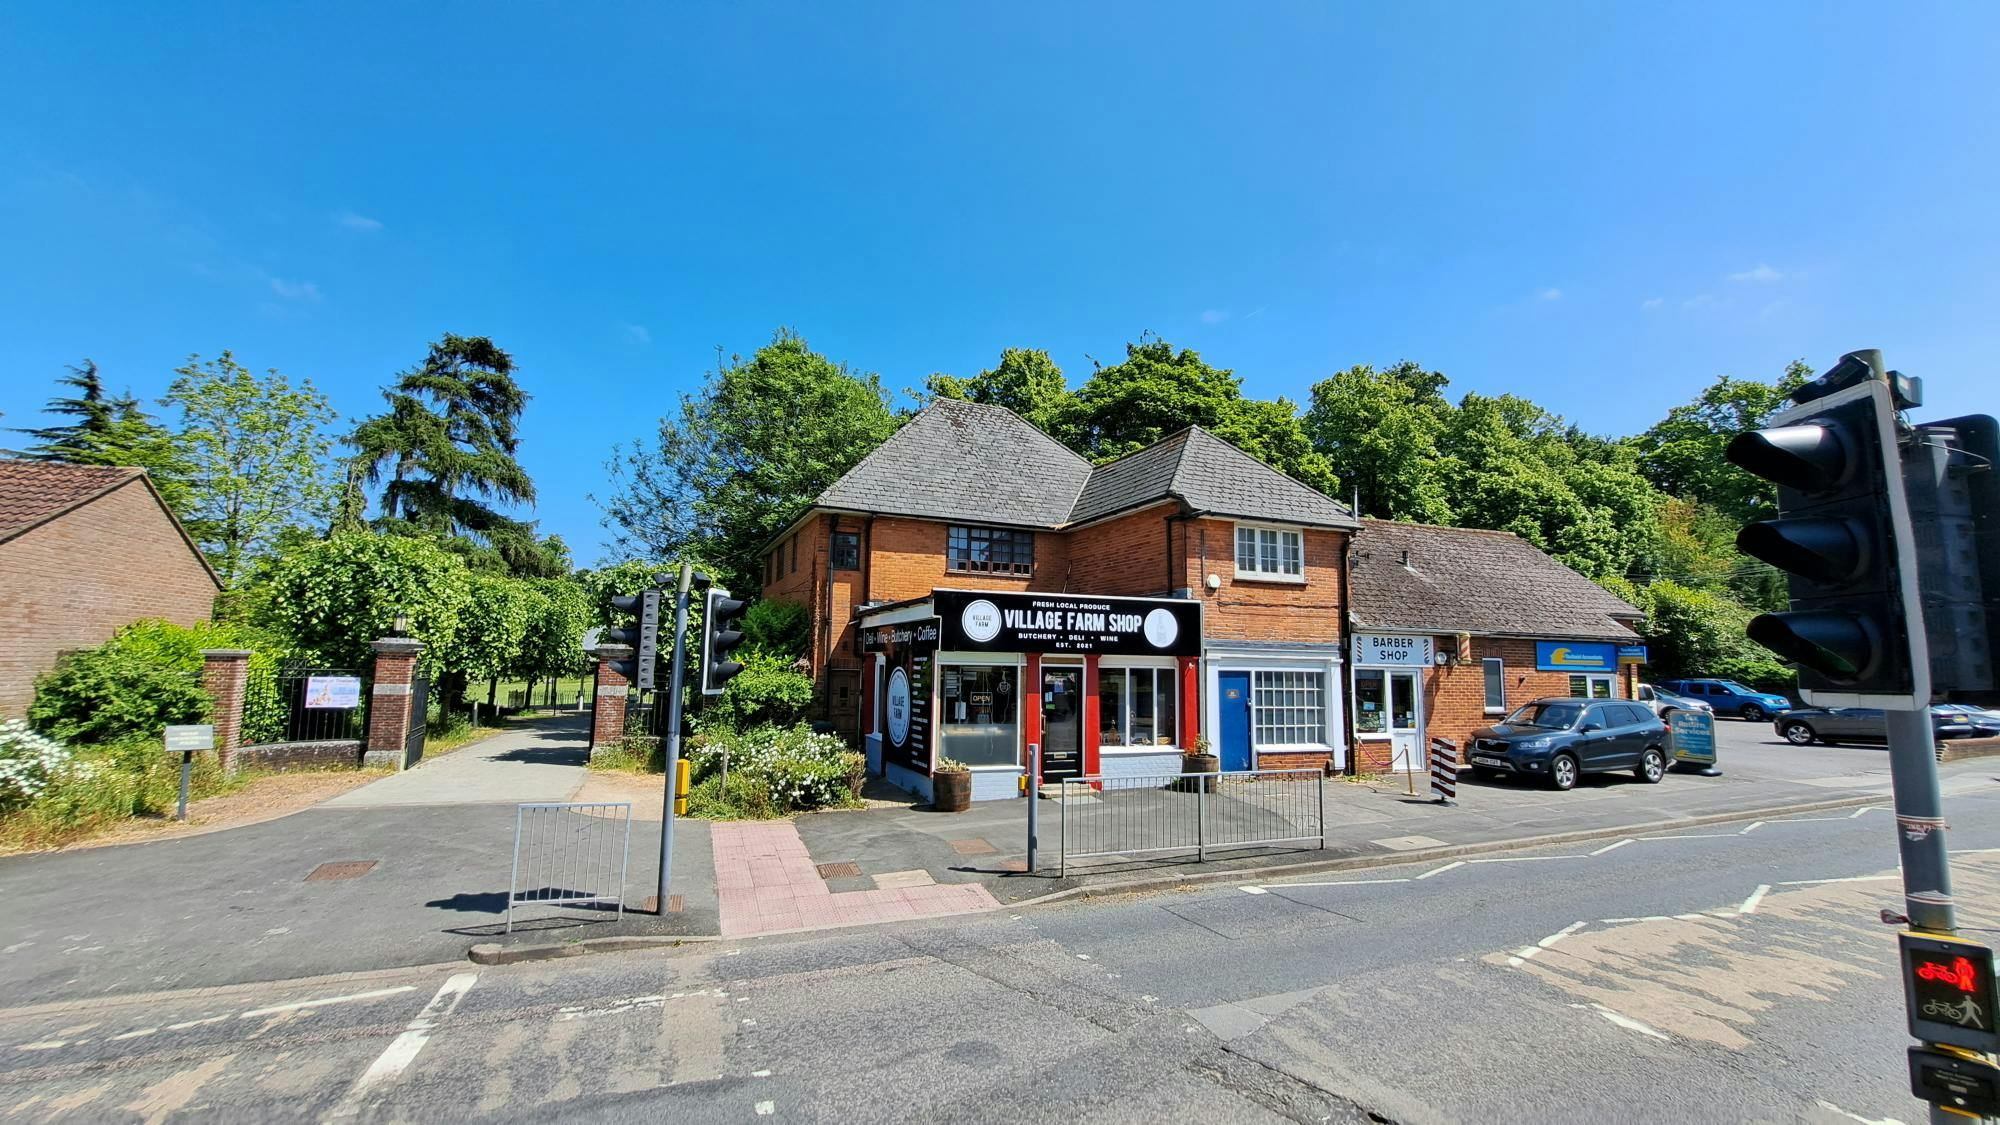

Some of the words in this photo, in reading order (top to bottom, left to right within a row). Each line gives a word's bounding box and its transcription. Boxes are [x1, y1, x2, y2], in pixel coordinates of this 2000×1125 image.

[1004, 609, 1062, 630] VILLAGE
[1067, 612, 1105, 631] FARM
[1109, 614, 1142, 633] SHOP
[866, 633, 875, 645] Deli
[877, 631, 889, 643] Wine
[891, 629, 913, 645] Butchery
[917, 625, 937, 641] Coffee
[1373, 637, 1414, 648] BARBER
[1380, 650, 1408, 661] SHOP
